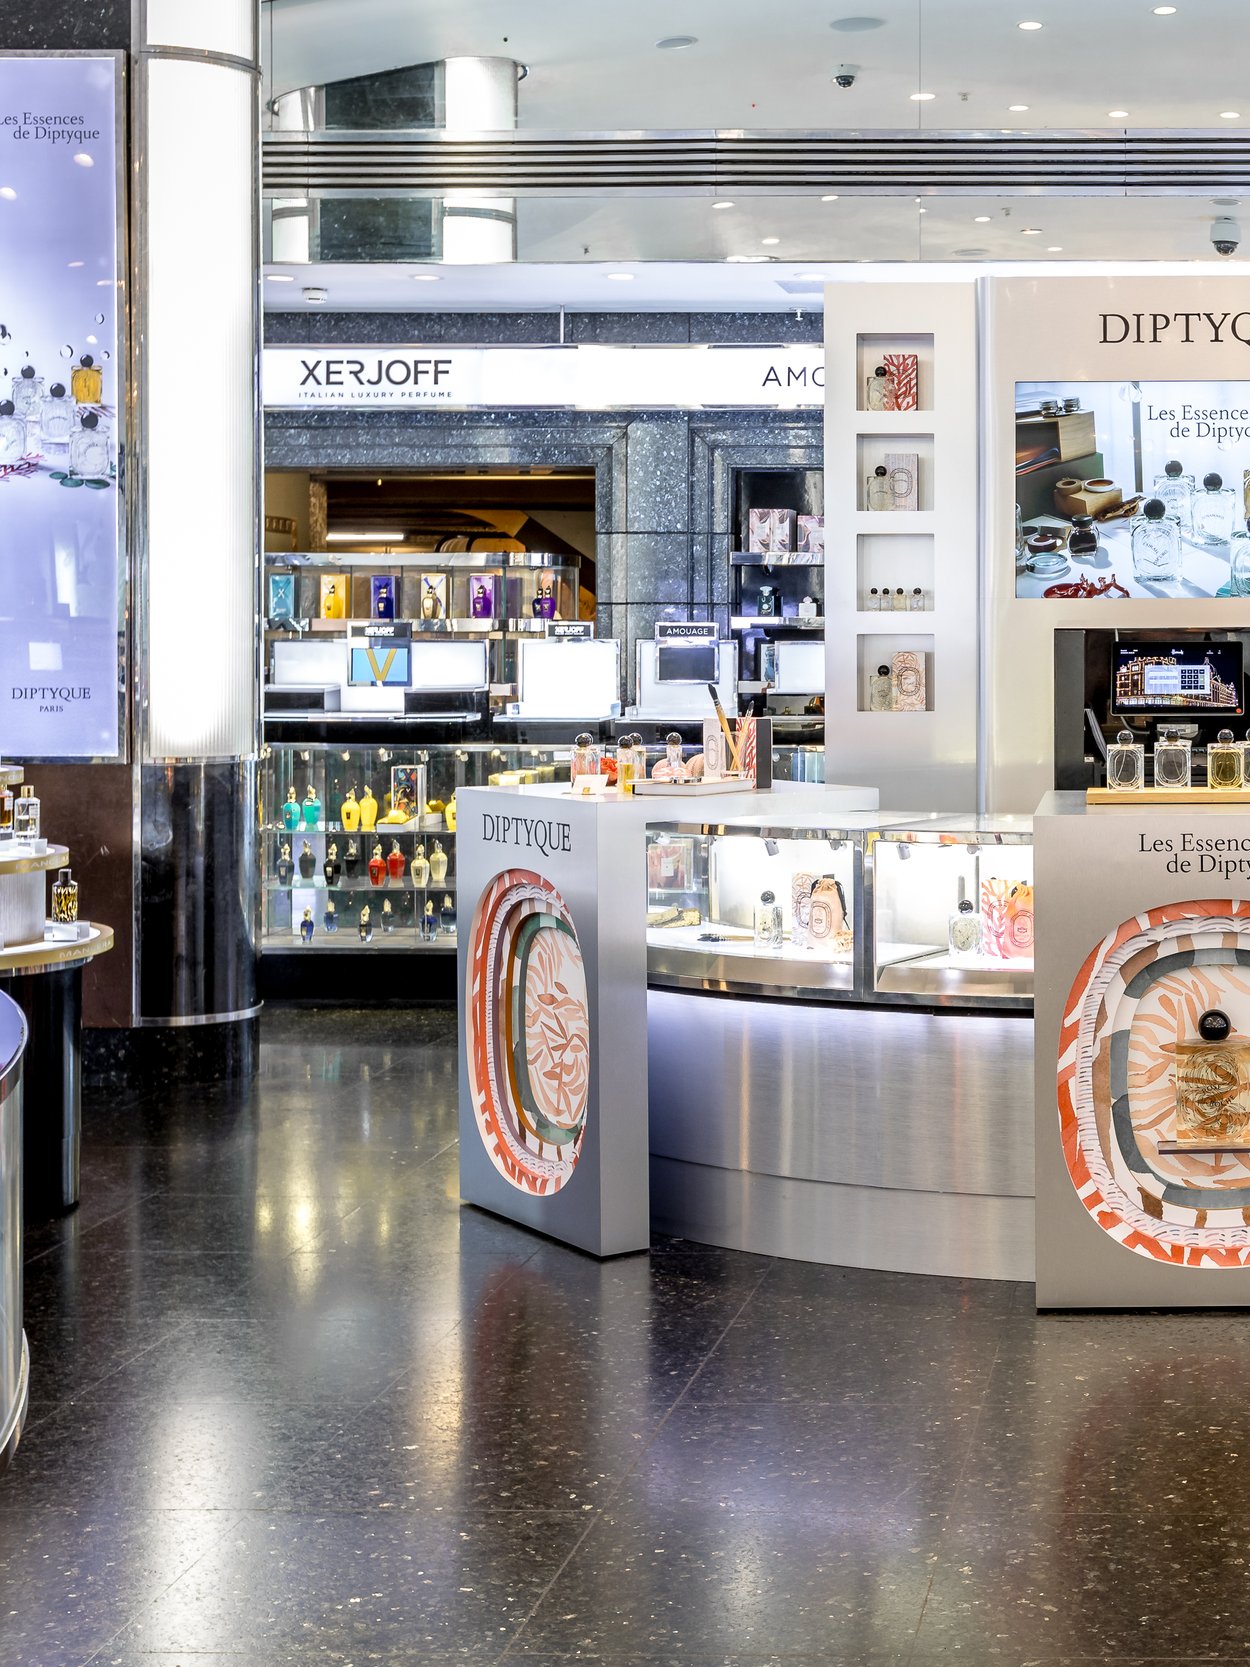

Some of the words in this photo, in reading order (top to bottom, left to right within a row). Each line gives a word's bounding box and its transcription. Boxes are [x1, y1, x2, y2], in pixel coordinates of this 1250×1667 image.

[23, 112, 84, 125] Essences
[13, 126, 30, 139] de
[34, 126, 100, 144] Diptyque
[300, 359, 452, 386] XERJOFF
[1147, 405, 1175, 421] Les
[1170, 421, 1190, 438] de
[666, 627, 709, 635] AMOUAGE
[12, 687, 91, 702] DIPTYQUE
[40, 705, 64, 713] PARIS
[482, 813, 572, 857] DIPTYQUE
[1138, 833, 1174, 852] Les
[1166, 853, 1191, 873] de
